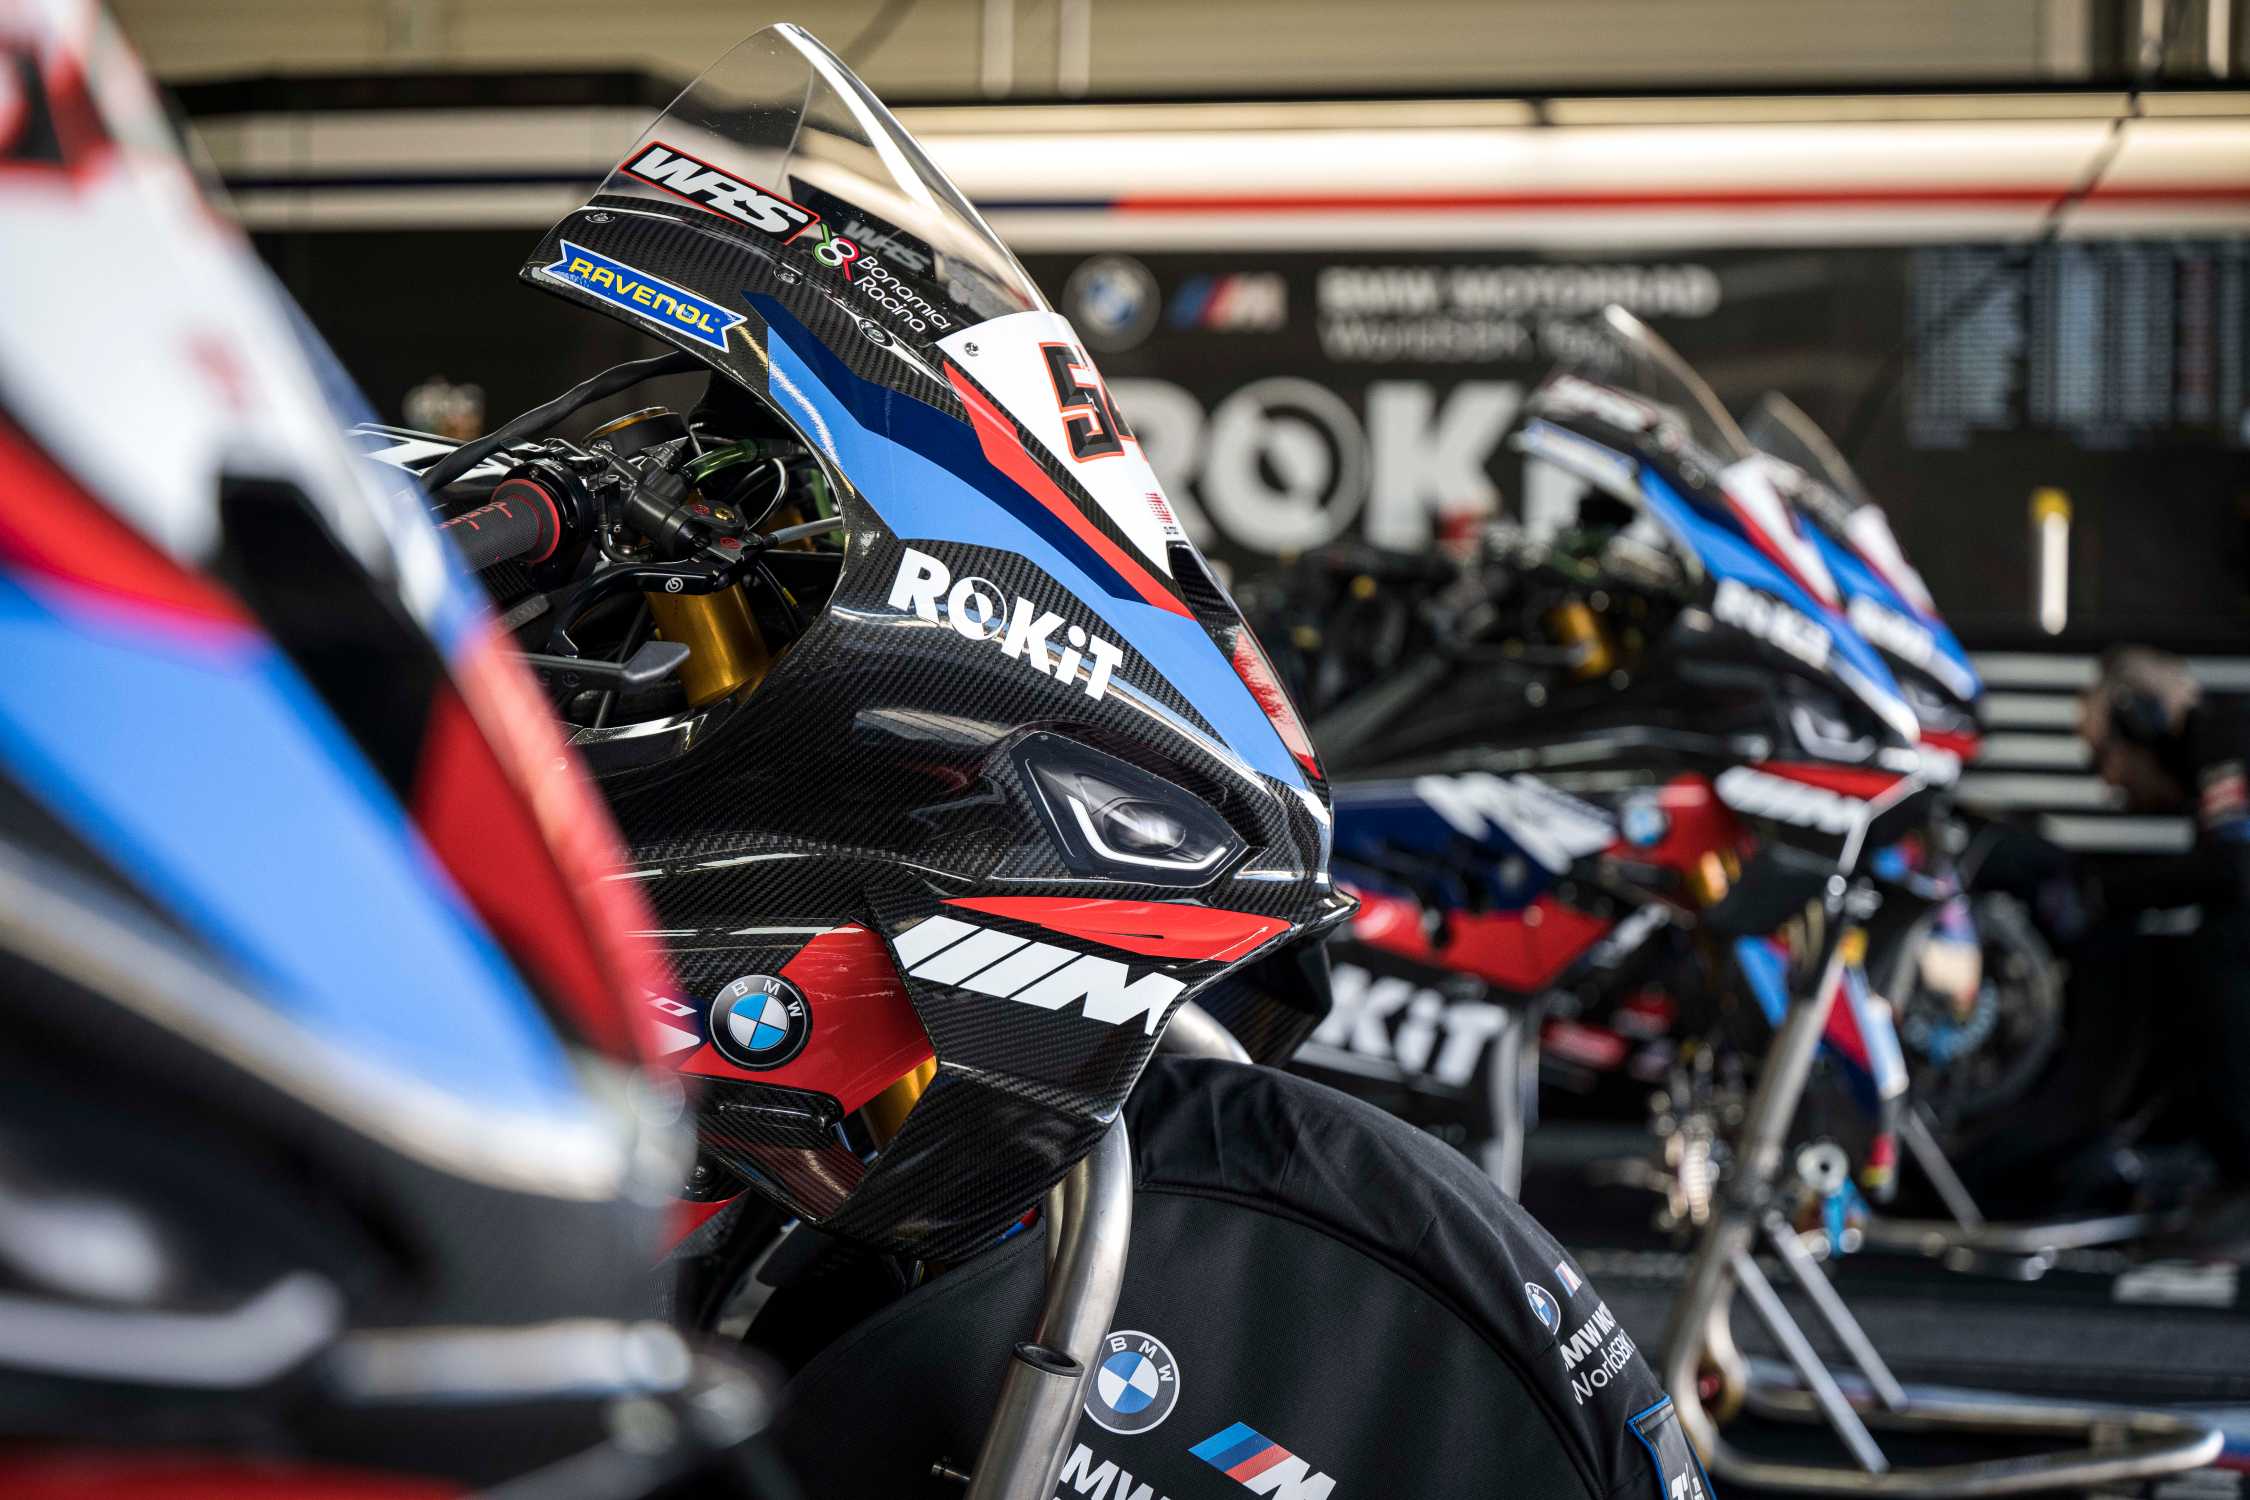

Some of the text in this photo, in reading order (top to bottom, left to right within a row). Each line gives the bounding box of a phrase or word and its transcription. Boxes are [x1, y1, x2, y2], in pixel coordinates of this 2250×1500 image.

[631, 147, 809, 233] WRS
[568, 257, 716, 334] RAVENOL
[856, 256, 952, 330] Bonamici
[887, 547, 1124, 702] ROKiT
[731, 979, 803, 1017] BMW
[1312, 962, 1508, 1088] KiT
[1110, 1336, 1174, 1383] BMW
